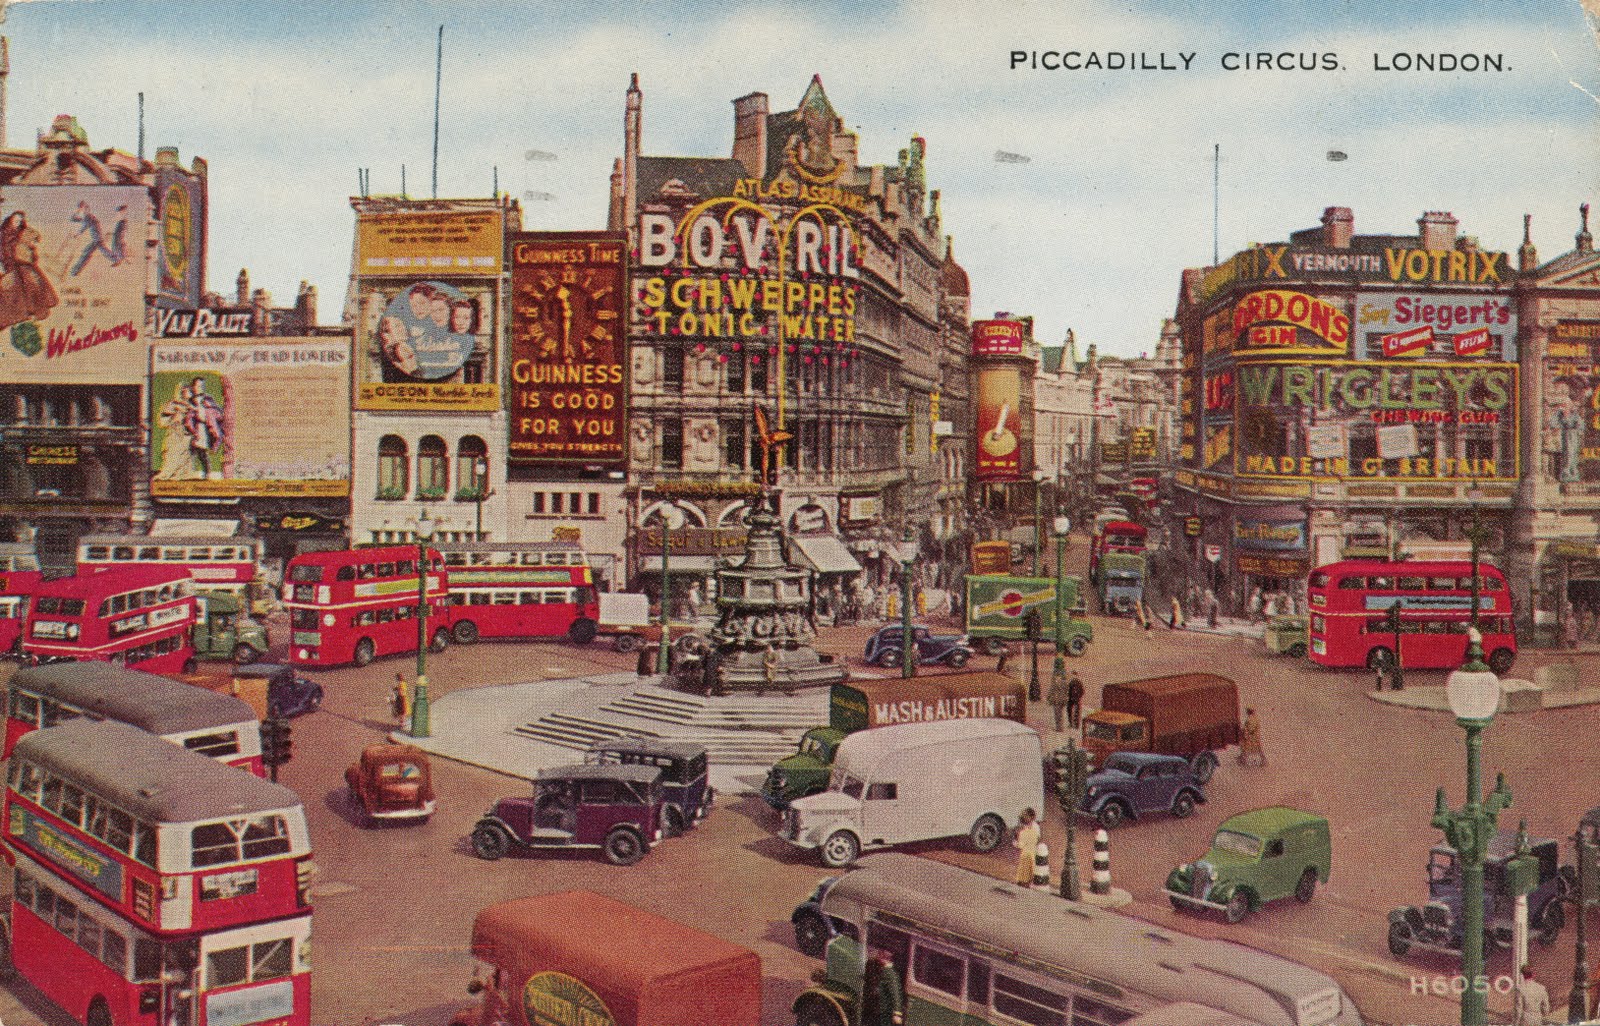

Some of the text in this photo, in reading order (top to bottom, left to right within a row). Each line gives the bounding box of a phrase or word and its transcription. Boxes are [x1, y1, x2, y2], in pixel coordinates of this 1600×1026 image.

[733, 178, 794, 199] ATLAS
[640, 213, 860, 278] BOVRIL
[1291, 253, 1380, 273] VERMOUTH
[1384, 248, 1501, 283] VOTRIX
[644, 277, 857, 317] SCHWEPPES
[1394, 296, 1511, 331] Siegert's
[654, 311, 857, 343] TONIC WATER
[1251, 327, 1298, 345] GIN
[252, 350, 290, 363] DEAD
[512, 359, 623, 384] GUINNESS
[520, 391, 615, 410] IS GOOD
[1240, 366, 1511, 411] WRIGLEY'S
[521, 417, 615, 436] FOR YOU
[1246, 454, 1313, 476] MADE
[1323, 457, 1349, 476] IN
[1398, 457, 1498, 476] BRITAIN
[935, 696, 995, 721] AUSTIN
